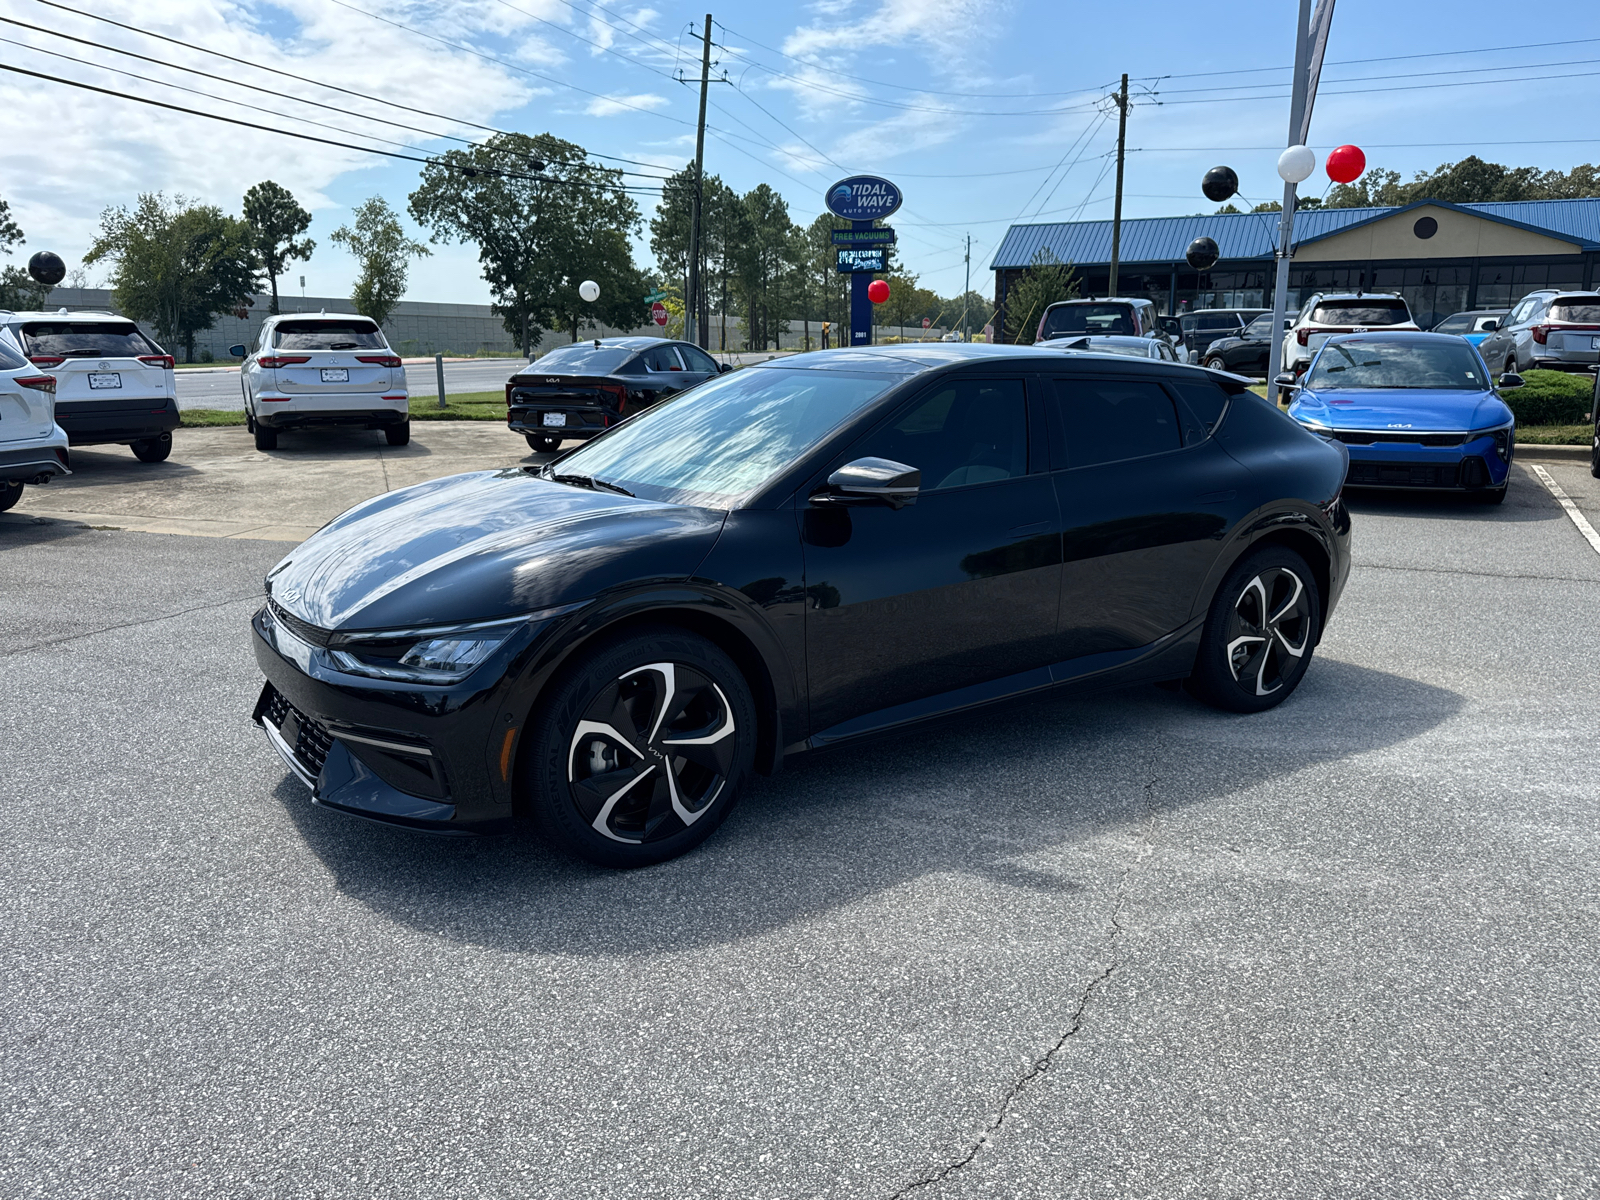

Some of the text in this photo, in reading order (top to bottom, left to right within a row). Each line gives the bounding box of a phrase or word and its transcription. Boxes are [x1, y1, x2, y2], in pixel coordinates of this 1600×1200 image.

[852, 184, 886, 195] TIDAL
[857, 195, 894, 207] WAVE
[834, 231, 890, 241] FREE VACUUMS
[653, 309, 667, 319] STOP
[280, 587, 302, 604] KIA
[595, 644, 646, 680] Continental
[549, 744, 599, 852] CONTINENTAL
